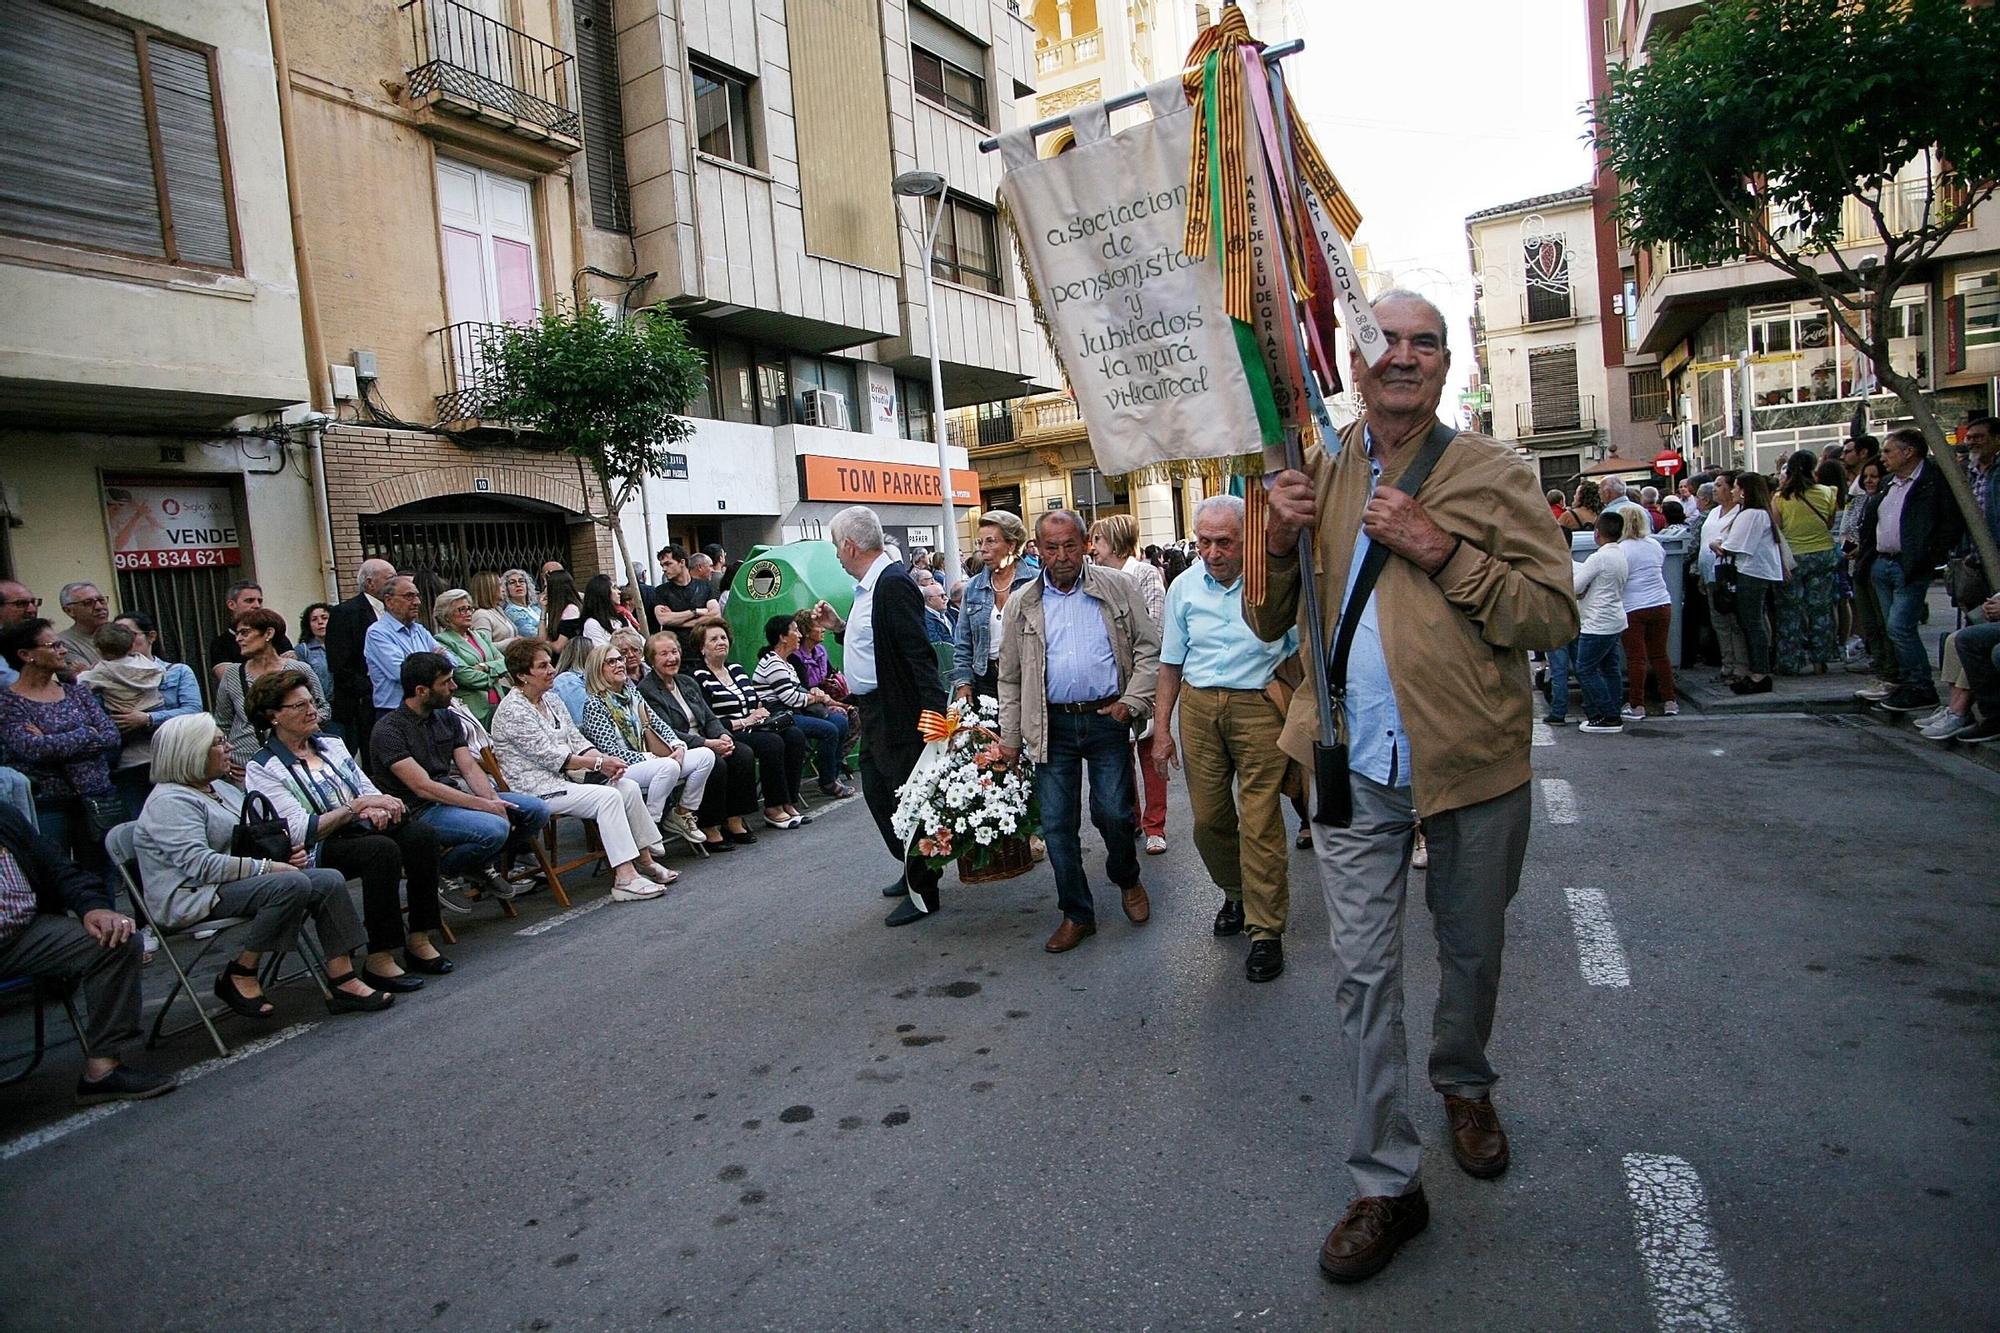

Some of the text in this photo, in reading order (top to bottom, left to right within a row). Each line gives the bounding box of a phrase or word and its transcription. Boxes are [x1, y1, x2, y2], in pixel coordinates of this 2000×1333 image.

[1245, 175, 1258, 226] MARE
[1046, 184, 1188, 247] asociacion
[1102, 233, 1134, 260] de
[1249, 230, 1264, 242] DE
[1301, 175, 1320, 221] SANT
[1321, 230, 1360, 313] PASQUAL
[1125, 292, 1143, 320] y
[1256, 290, 1272, 304] DE
[1080, 305, 1203, 358] jubilados
[1099, 336, 1197, 379] la murá
[1104, 365, 1209, 410] villarreal
[478, 480, 487, 490] 10
[837, 467, 942, 497] TOM PARKER
[183, 502, 205, 513] Siglo
[166, 528, 238, 544] VENDE
[115, 550, 225, 569] 964 834 621
